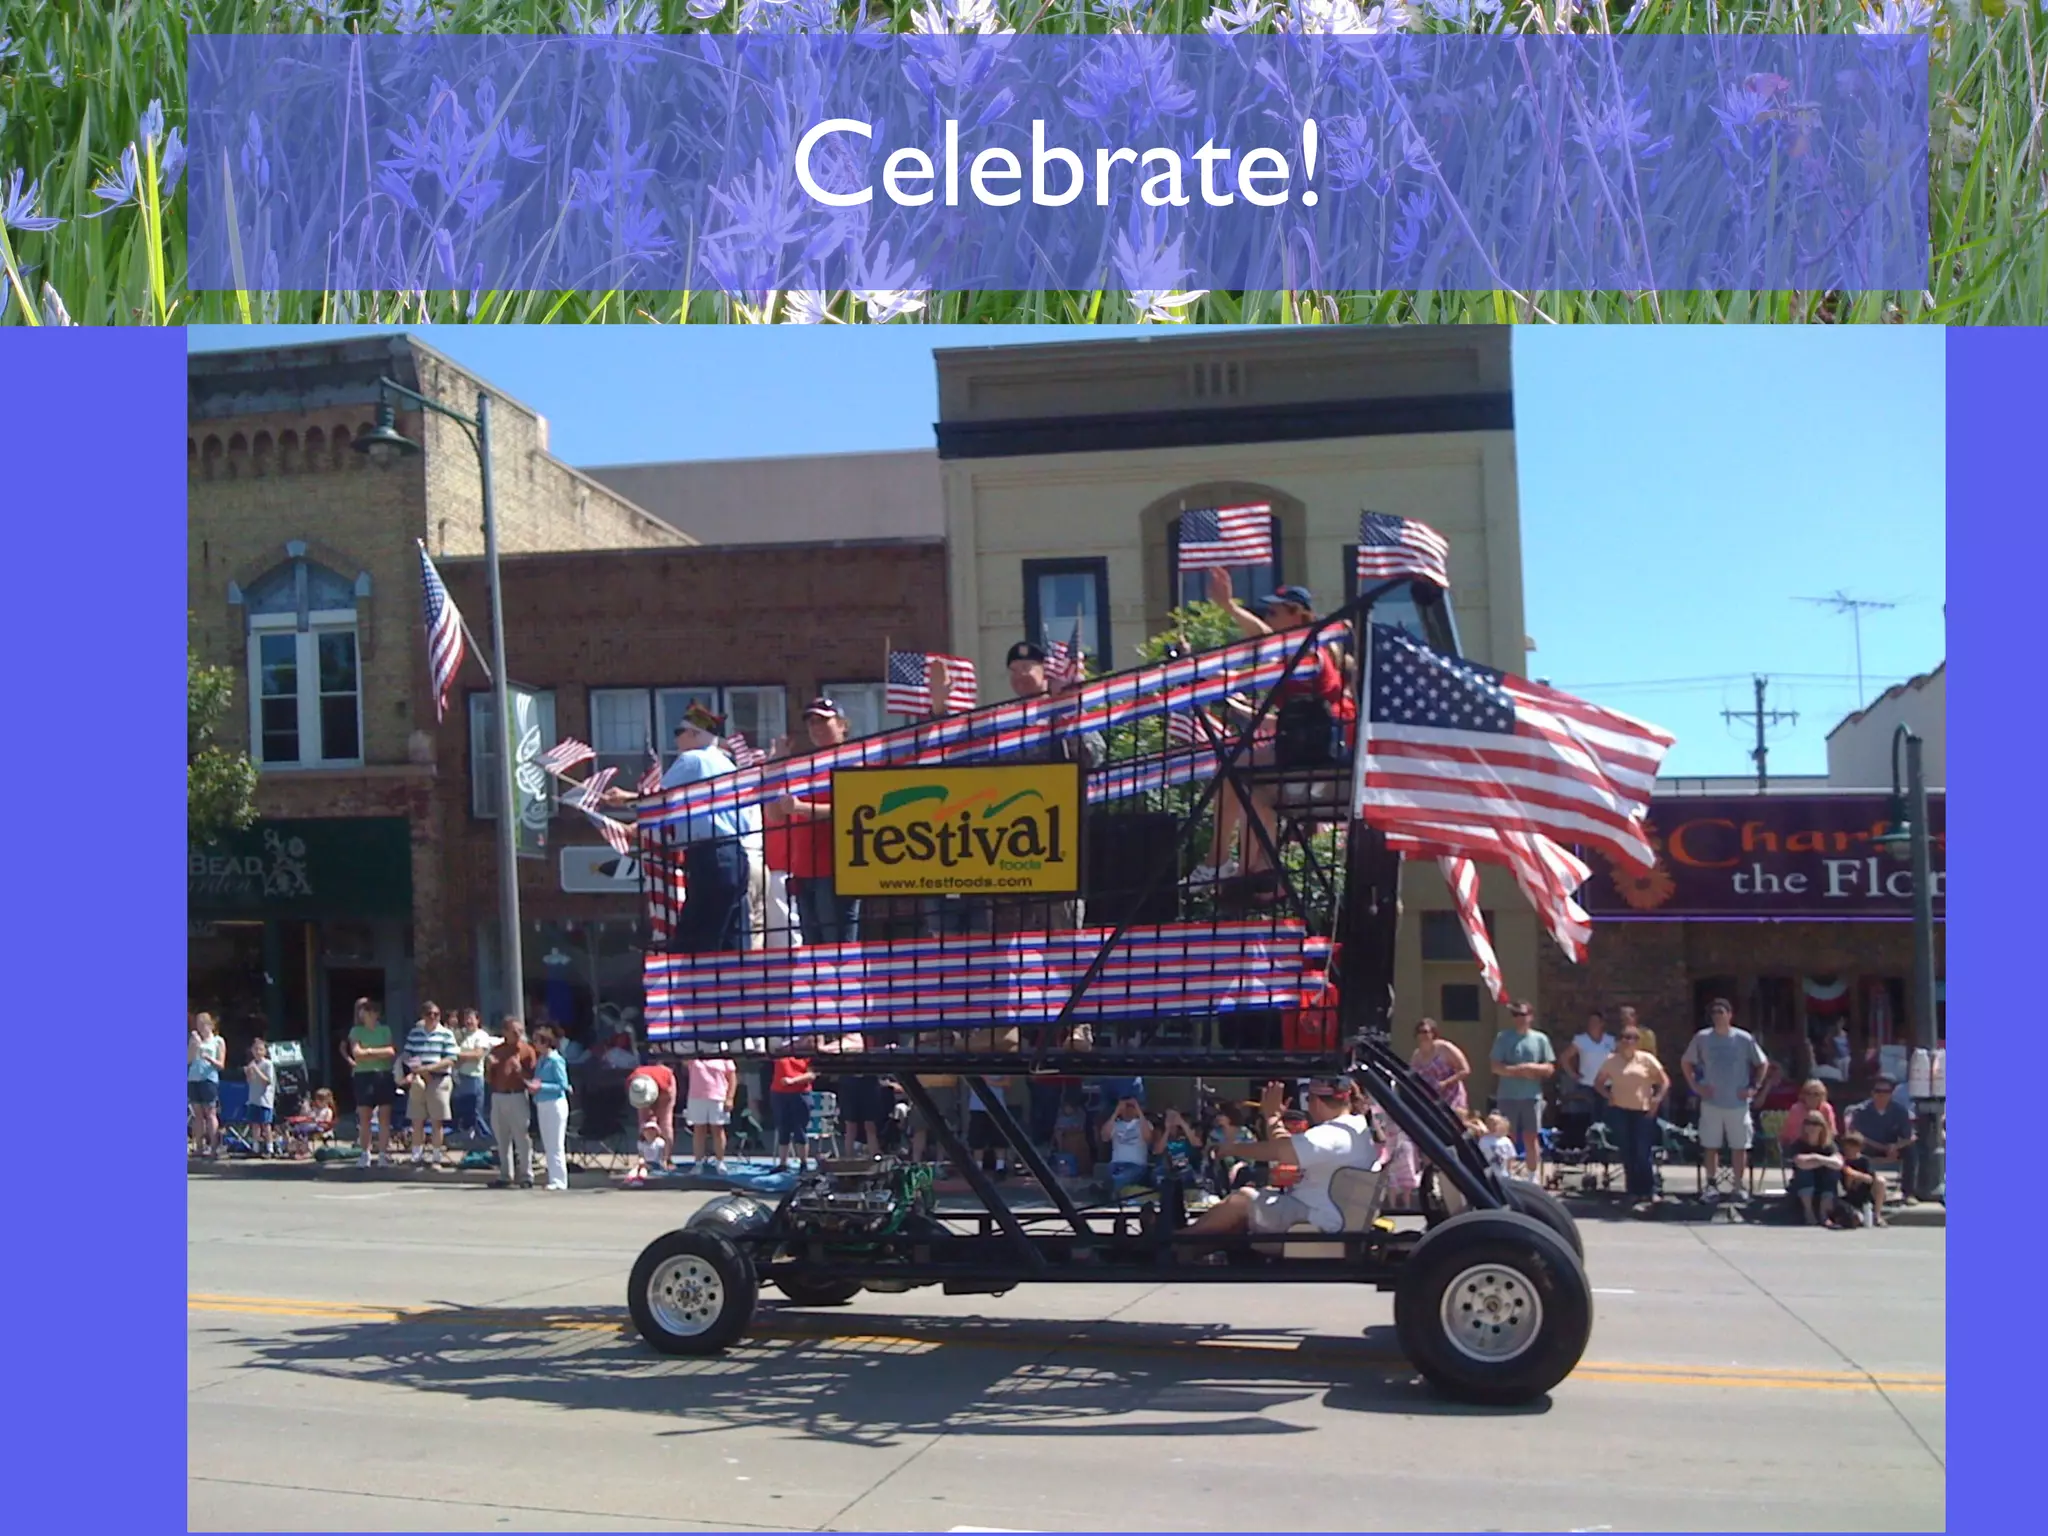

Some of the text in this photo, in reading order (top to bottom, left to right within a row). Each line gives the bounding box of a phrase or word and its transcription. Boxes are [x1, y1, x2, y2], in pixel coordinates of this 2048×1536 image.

[846, 804, 1064, 867] festival
[189, 854, 263, 876] BEAD
[1000, 859, 1041, 871] foods
[879, 876, 1033, 889] www.festfoods.com
[1732, 863, 1808, 894] the
